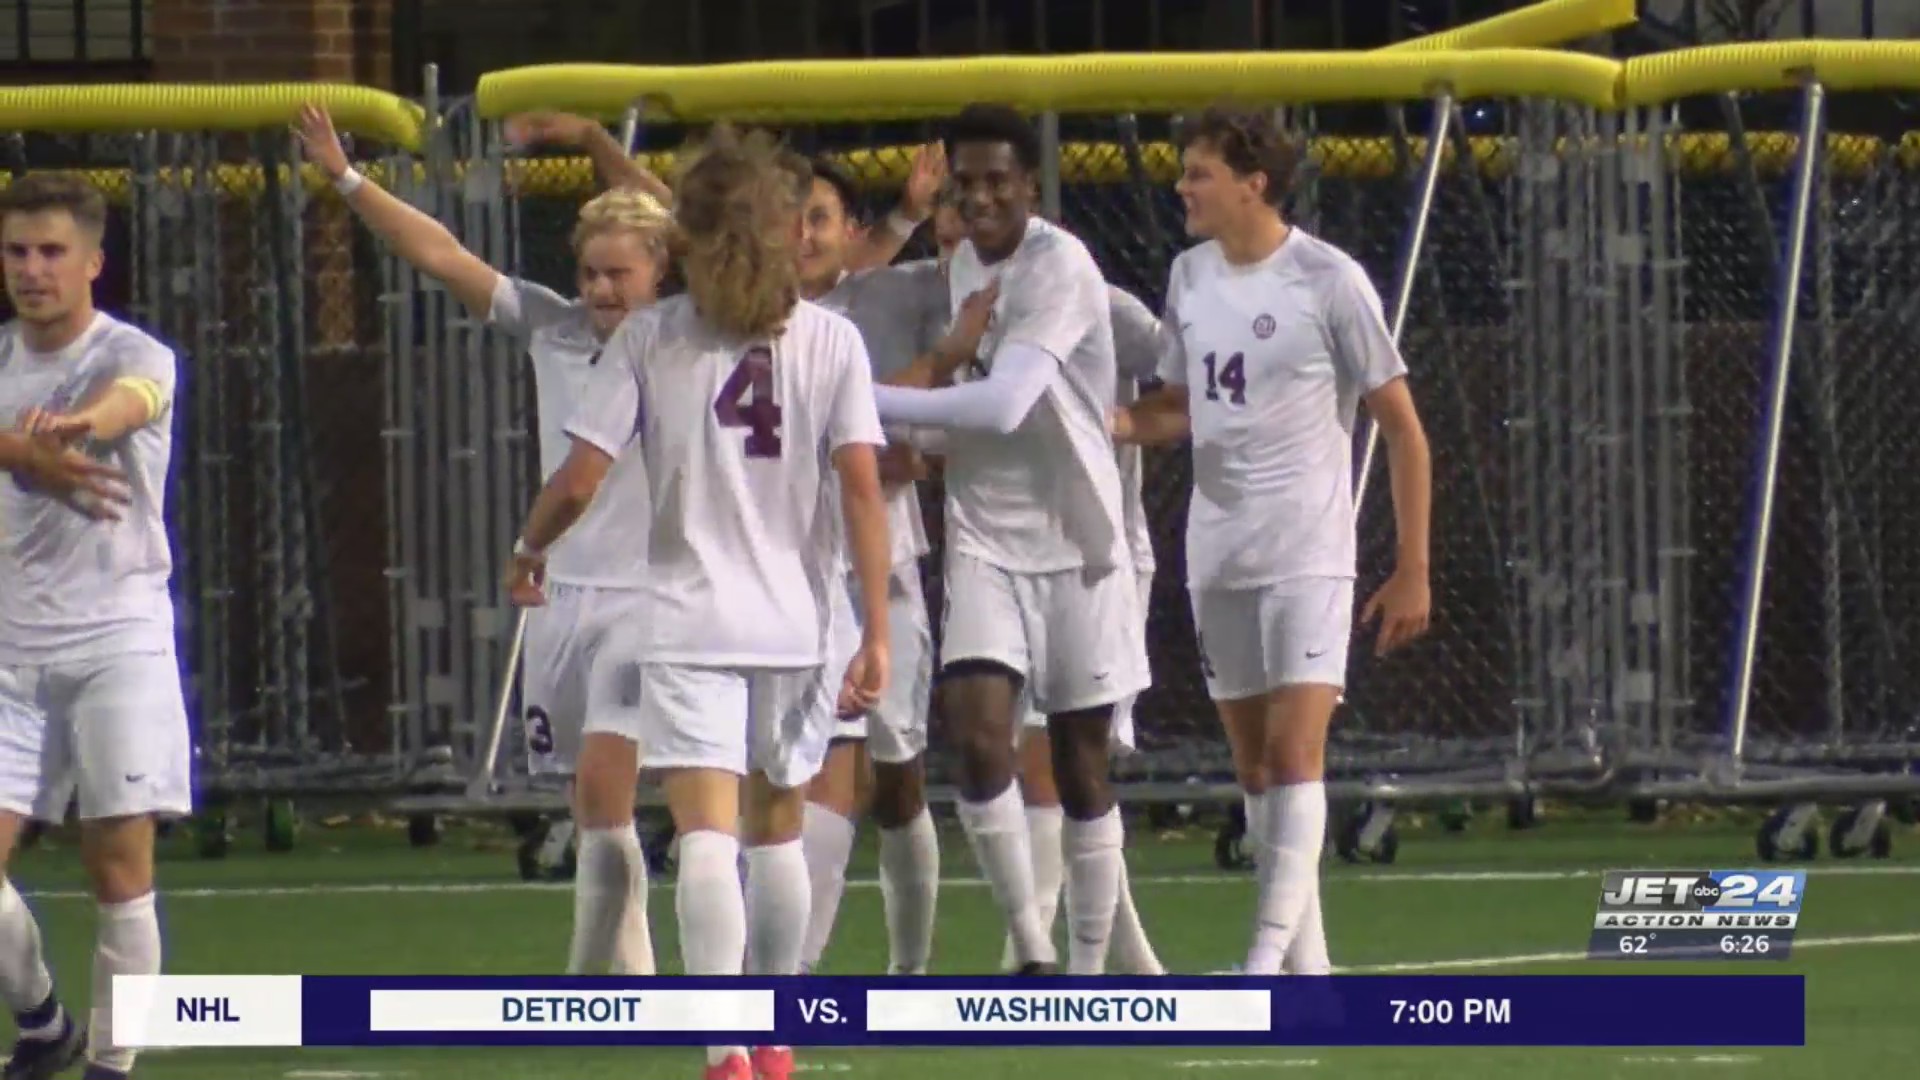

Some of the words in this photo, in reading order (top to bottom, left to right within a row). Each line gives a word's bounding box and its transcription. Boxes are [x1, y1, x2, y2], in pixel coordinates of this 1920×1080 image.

[714, 346, 783, 458] 4
[1203, 351, 1246, 405] 14
[527, 704, 553, 754] 3
